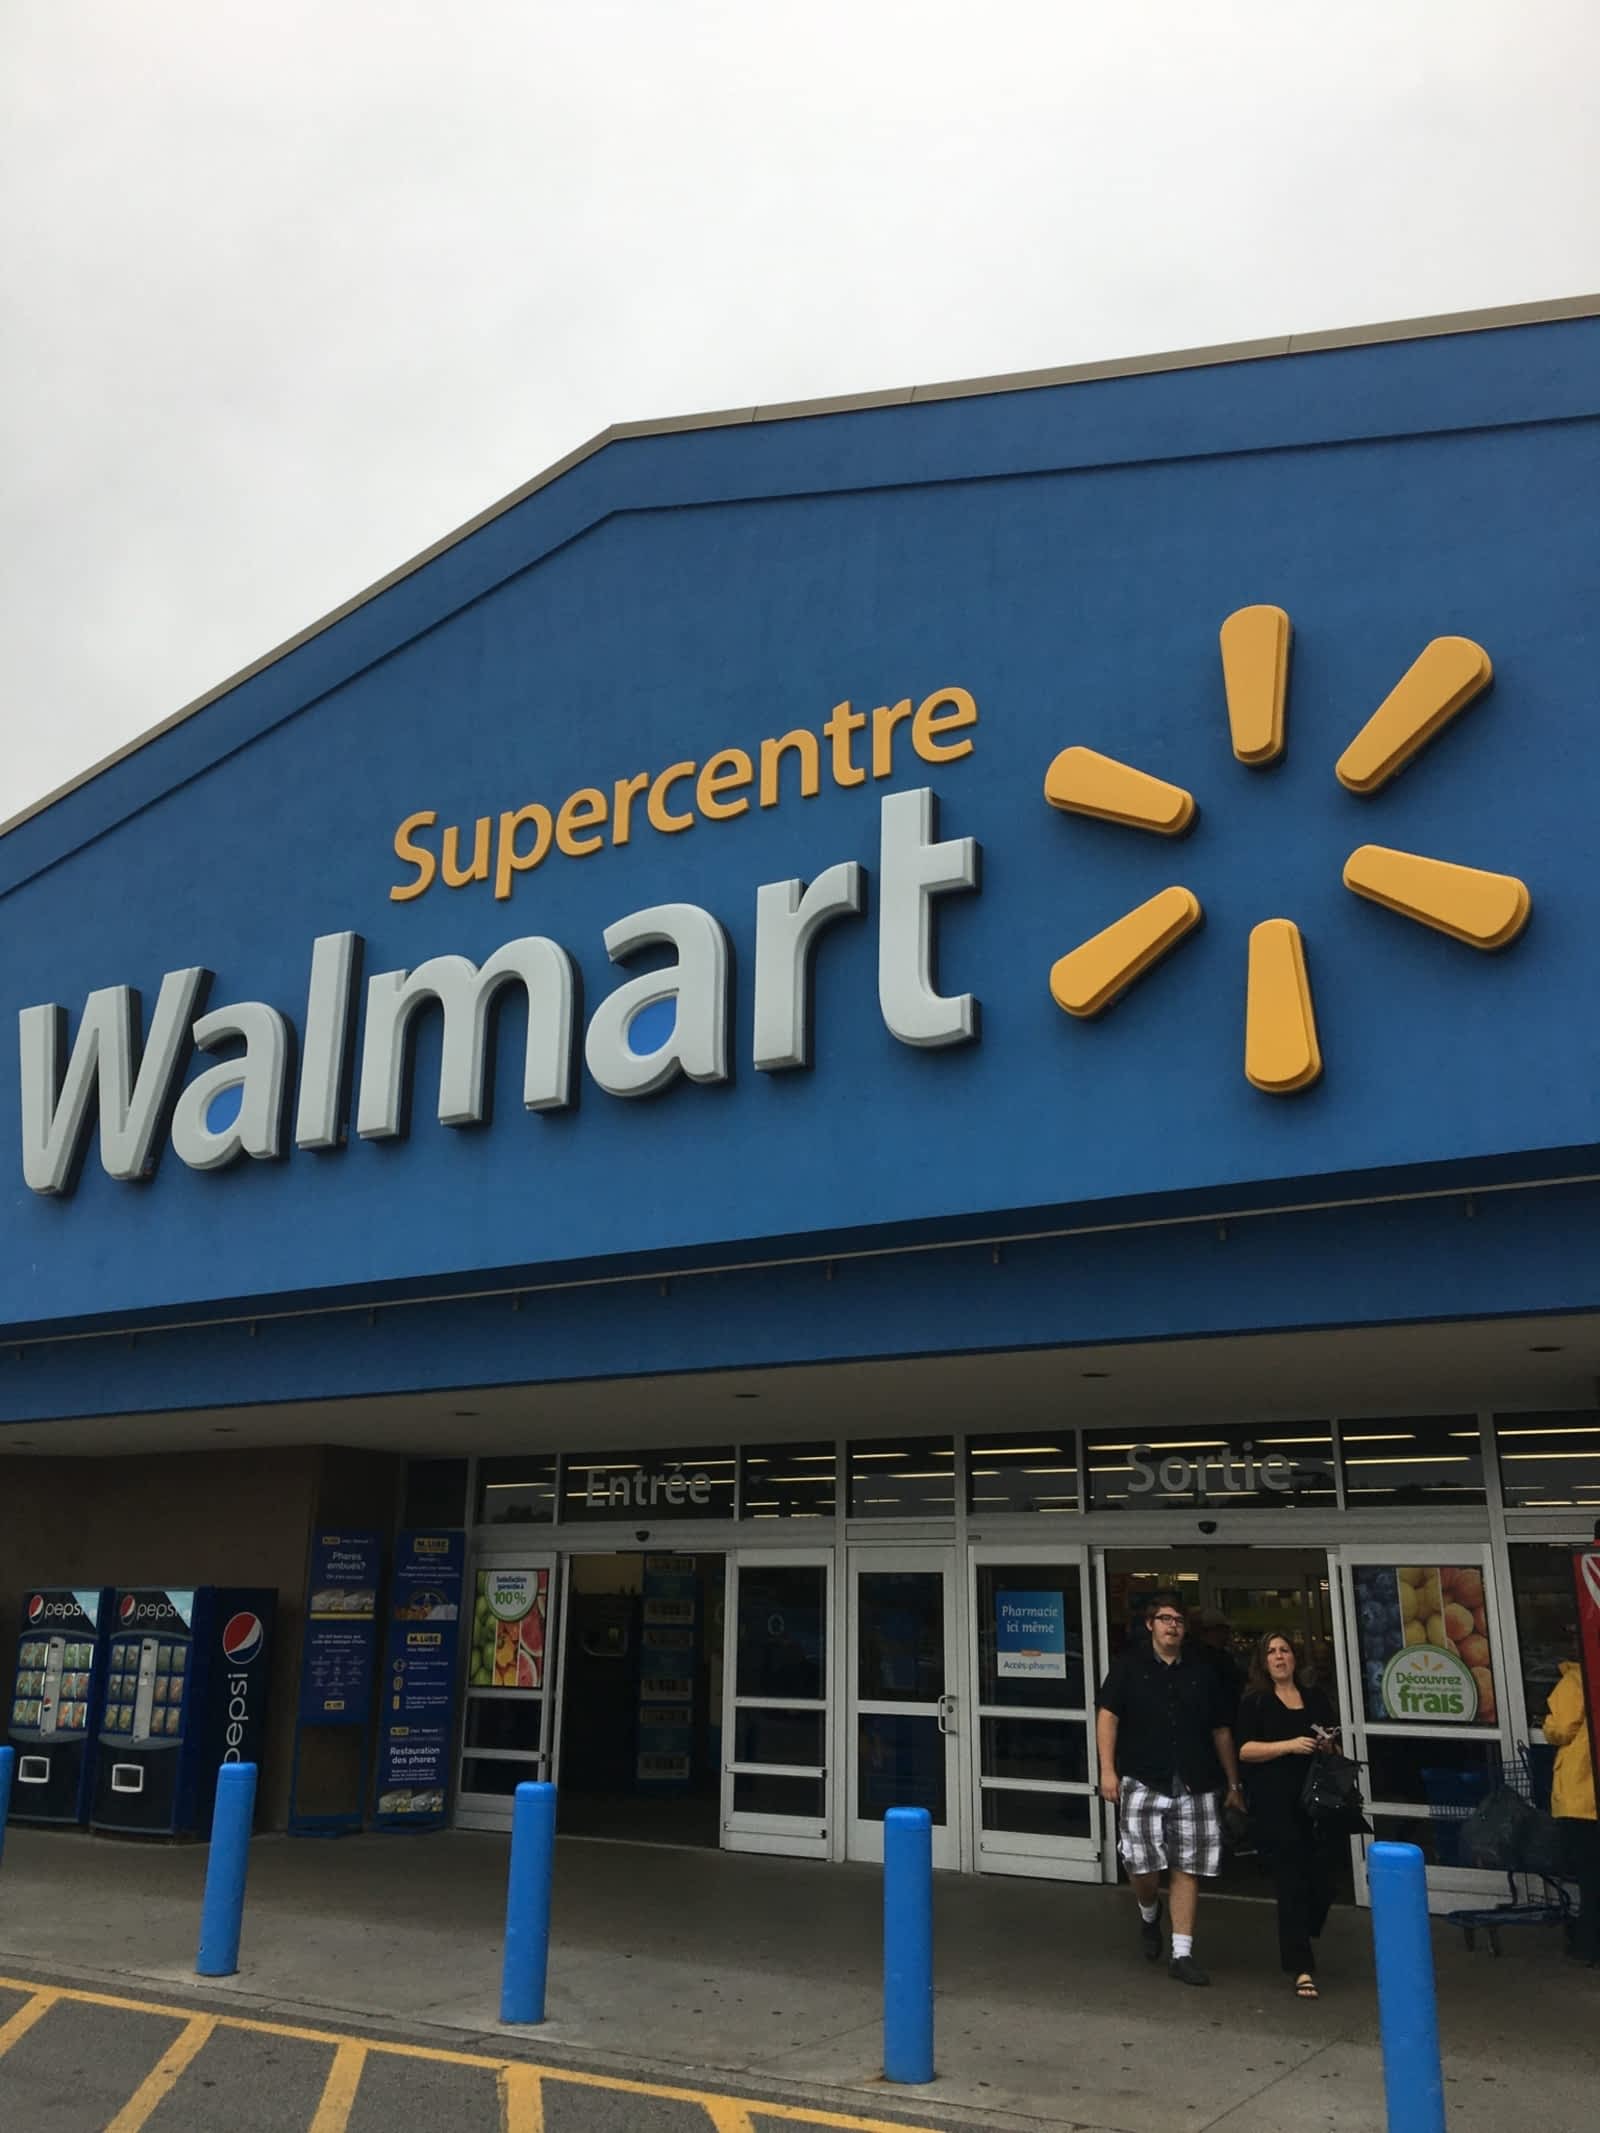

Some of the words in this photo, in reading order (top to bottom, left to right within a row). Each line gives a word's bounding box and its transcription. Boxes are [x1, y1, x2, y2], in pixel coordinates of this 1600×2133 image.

[389, 686, 979, 901] Supercentre
[19, 787, 979, 1196] Walmart
[1126, 1440, 1292, 1493] Sortie
[585, 1464, 712, 1507] Entrée
[1001, 1605, 1059, 1617] Pharmacie
[1007, 1620, 1019, 1633] ici
[1022, 1620, 1055, 1633] même
[1395, 1672, 1462, 1685] Découvrez
[1398, 1684, 1465, 1714] frais
[390, 1746, 441, 1755] Restauration
[391, 1756, 407, 1765] des
[408, 1756, 437, 1765] phares
